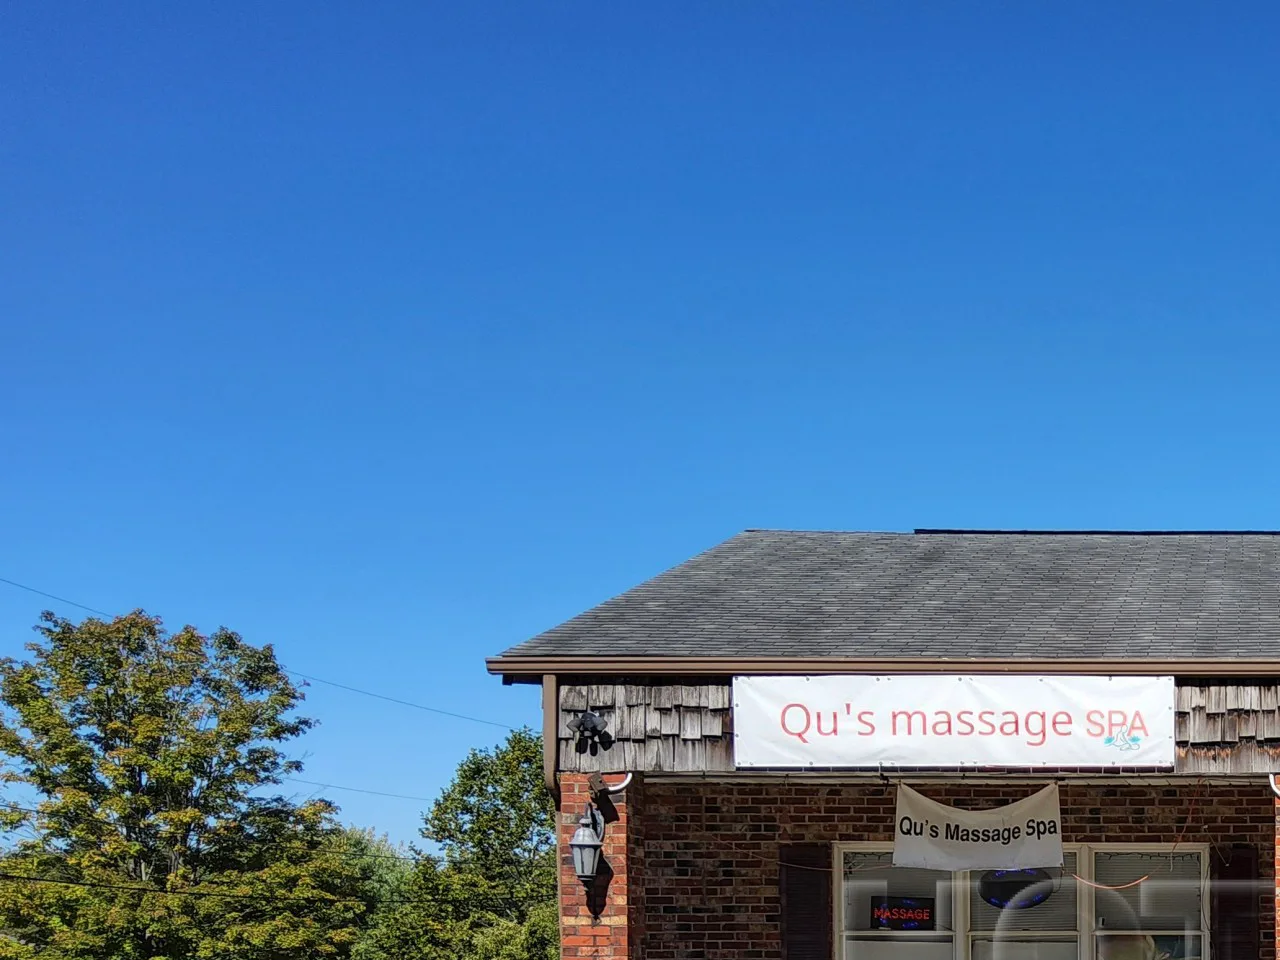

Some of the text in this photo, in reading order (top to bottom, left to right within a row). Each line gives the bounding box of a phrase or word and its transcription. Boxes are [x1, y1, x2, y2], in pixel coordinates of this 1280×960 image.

[780, 702, 1149, 747] Qu's massage SPA
[900, 816, 1058, 845] Qu's Massage Spa
[873, 907, 931, 920] MASSAGE
